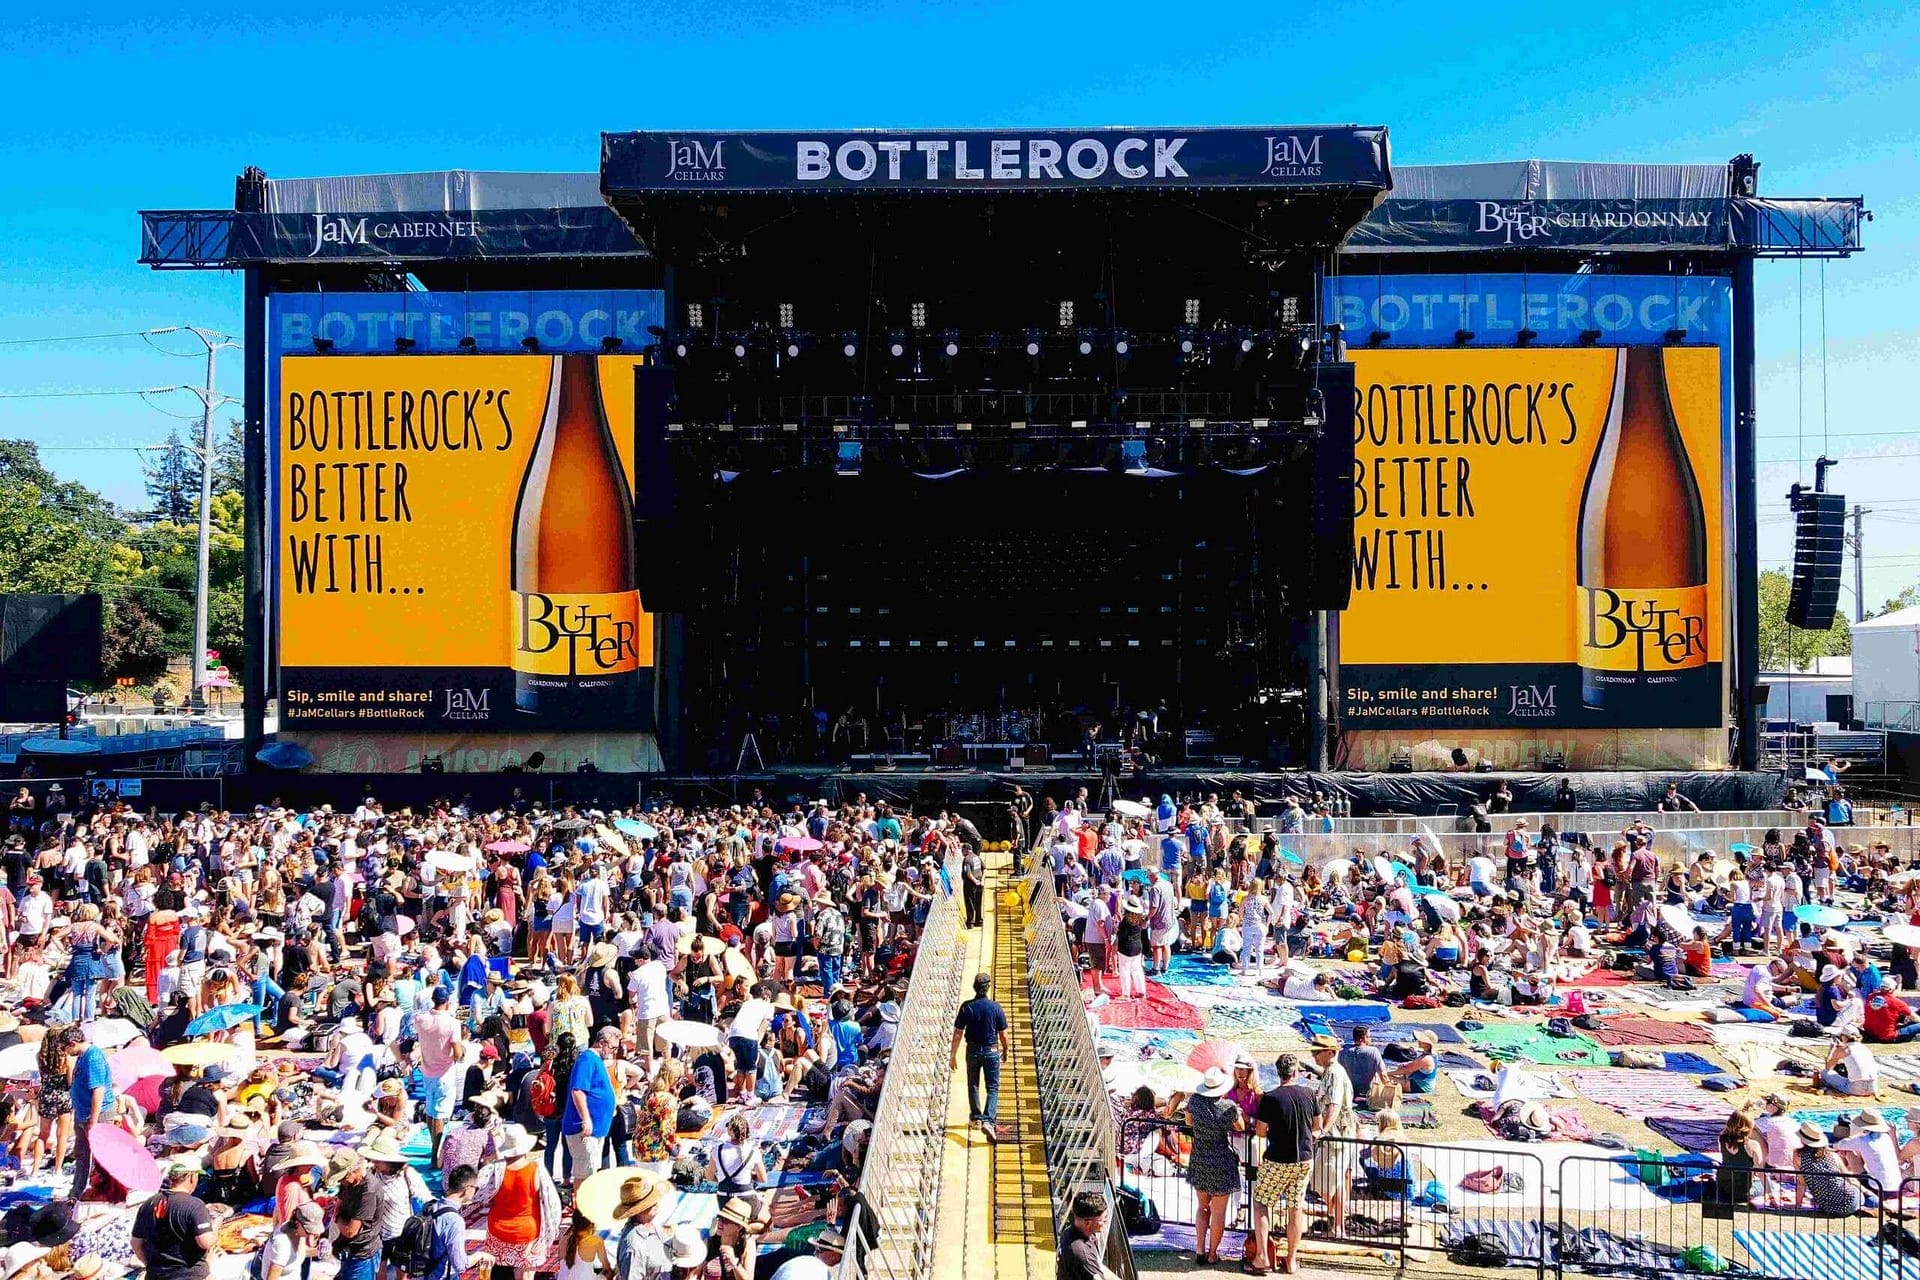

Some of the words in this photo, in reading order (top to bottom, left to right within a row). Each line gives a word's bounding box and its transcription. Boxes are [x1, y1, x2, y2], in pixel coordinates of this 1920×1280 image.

[665, 140, 727, 178] JaM
[797, 138, 1189, 180] BOTTLEROCK
[1261, 135, 1324, 174] JaM
[1271, 166, 1321, 177] CELLARS
[674, 171, 724, 181] CELLARS
[308, 214, 369, 257] JaM
[374, 221, 480, 239] CABERNET
[1556, 211, 1712, 228] CHARDONNAY
[281, 308, 649, 350] BOTTLEROCK
[1335, 294, 1711, 332] BOTTLEROCK
[289, 388, 513, 452] BOTTLEROCK'S
[290, 462, 412, 523] BETTER
[1354, 457, 1475, 518] BETTER
[289, 533, 424, 595] WITH...
[1352, 528, 1488, 590] WITH...
[287, 690, 313, 703] Sip,
[317, 690, 356, 702] smile
[359, 690, 384, 702] and
[388, 690, 433, 702] share!
[442, 688, 491, 717] JaM
[1347, 688, 1374, 702] Sip,
[1378, 687, 1418, 700] smile
[1422, 687, 1448, 700] and
[1452, 687, 1497, 699] share!
[1348, 706, 1418, 716] #JaMCellars
[1421, 706, 1489, 716] #BottleRock
[1507, 685, 1557, 715] JaM
[287, 708, 356, 718] #JaMCellars
[358, 708, 425, 718] #BottleRock
[449, 711, 489, 720] CELLARS
[1514, 708, 1556, 717] CELLARS
